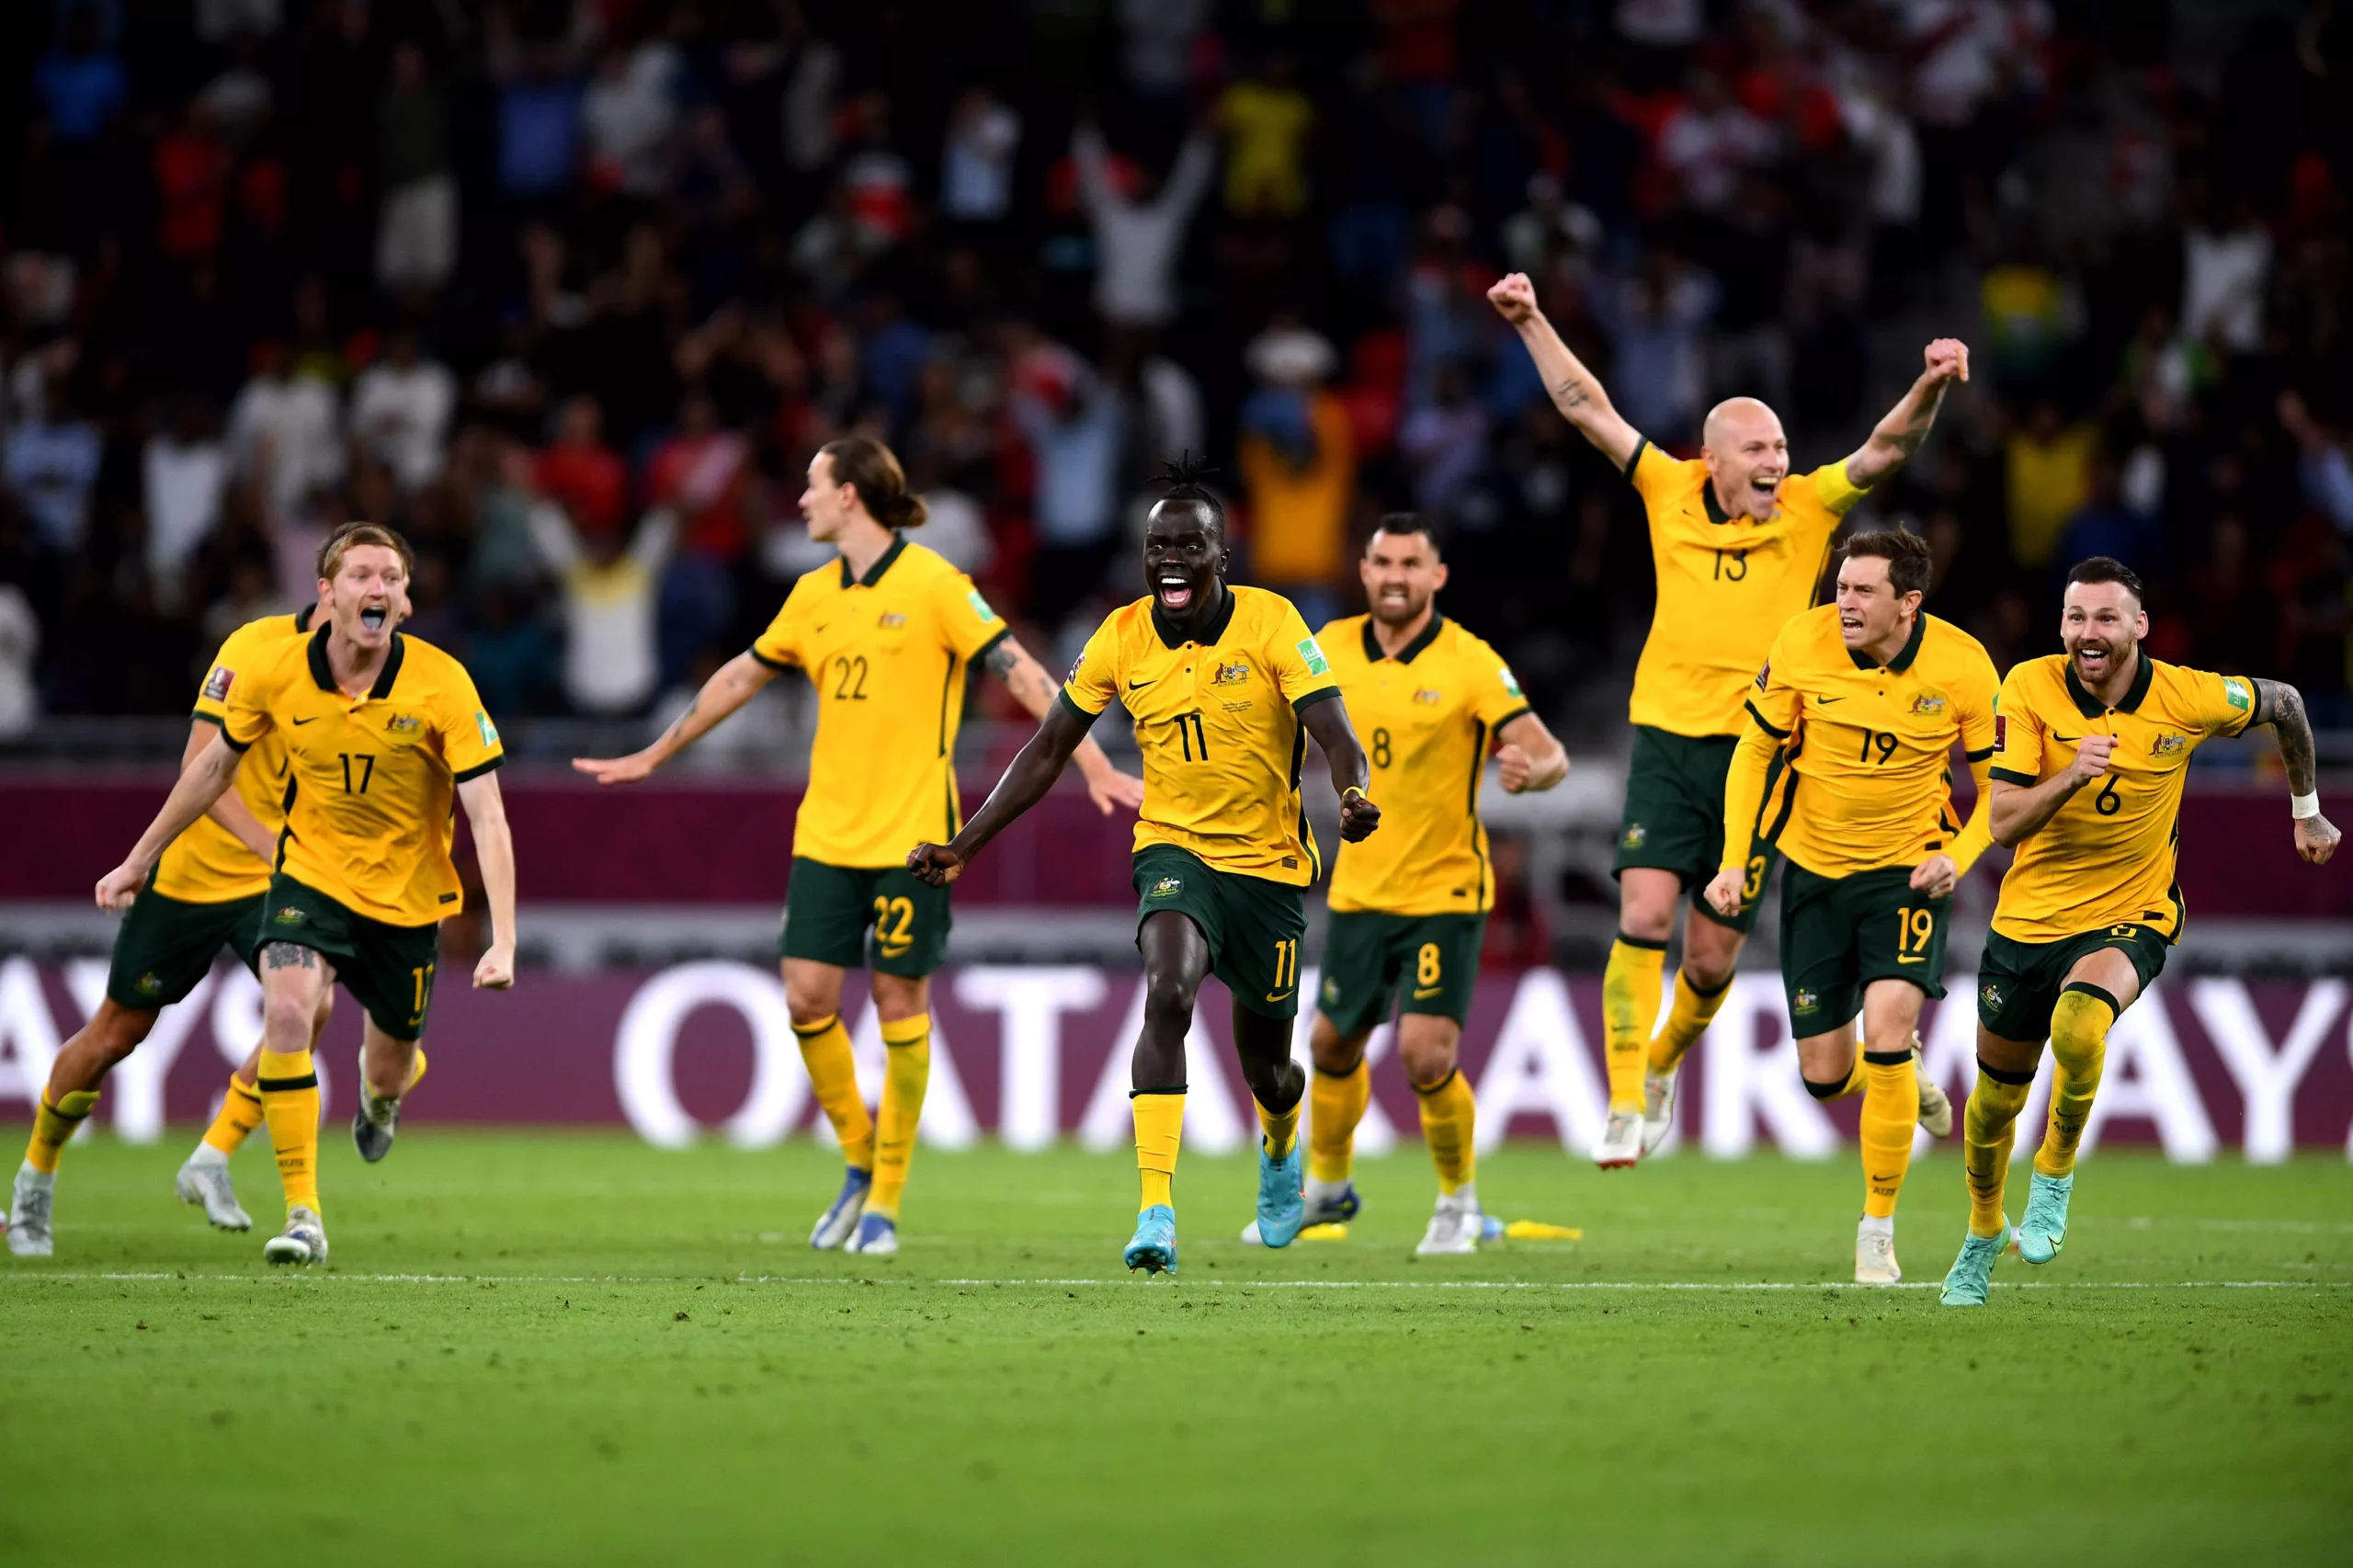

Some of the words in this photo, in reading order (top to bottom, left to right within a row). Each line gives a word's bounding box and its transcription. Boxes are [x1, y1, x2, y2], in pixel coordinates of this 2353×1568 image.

[1713, 548, 1748, 582] 13
[835, 655, 869, 700] 22
[1174, 714, 1209, 763] 11
[1372, 727, 1392, 769] 8
[1859, 727, 1899, 766] 19
[338, 753, 375, 794] 17
[2095, 773, 2121, 816] 6
[1742, 854, 1767, 900] 3
[874, 895, 915, 945] 22
[1897, 907, 1933, 952] 19
[1275, 938, 1296, 988] 11
[1417, 942, 1441, 986] 8
[1469, 965, 2353, 1167] ARAY
[2052, 1120, 2081, 1133] AUS
